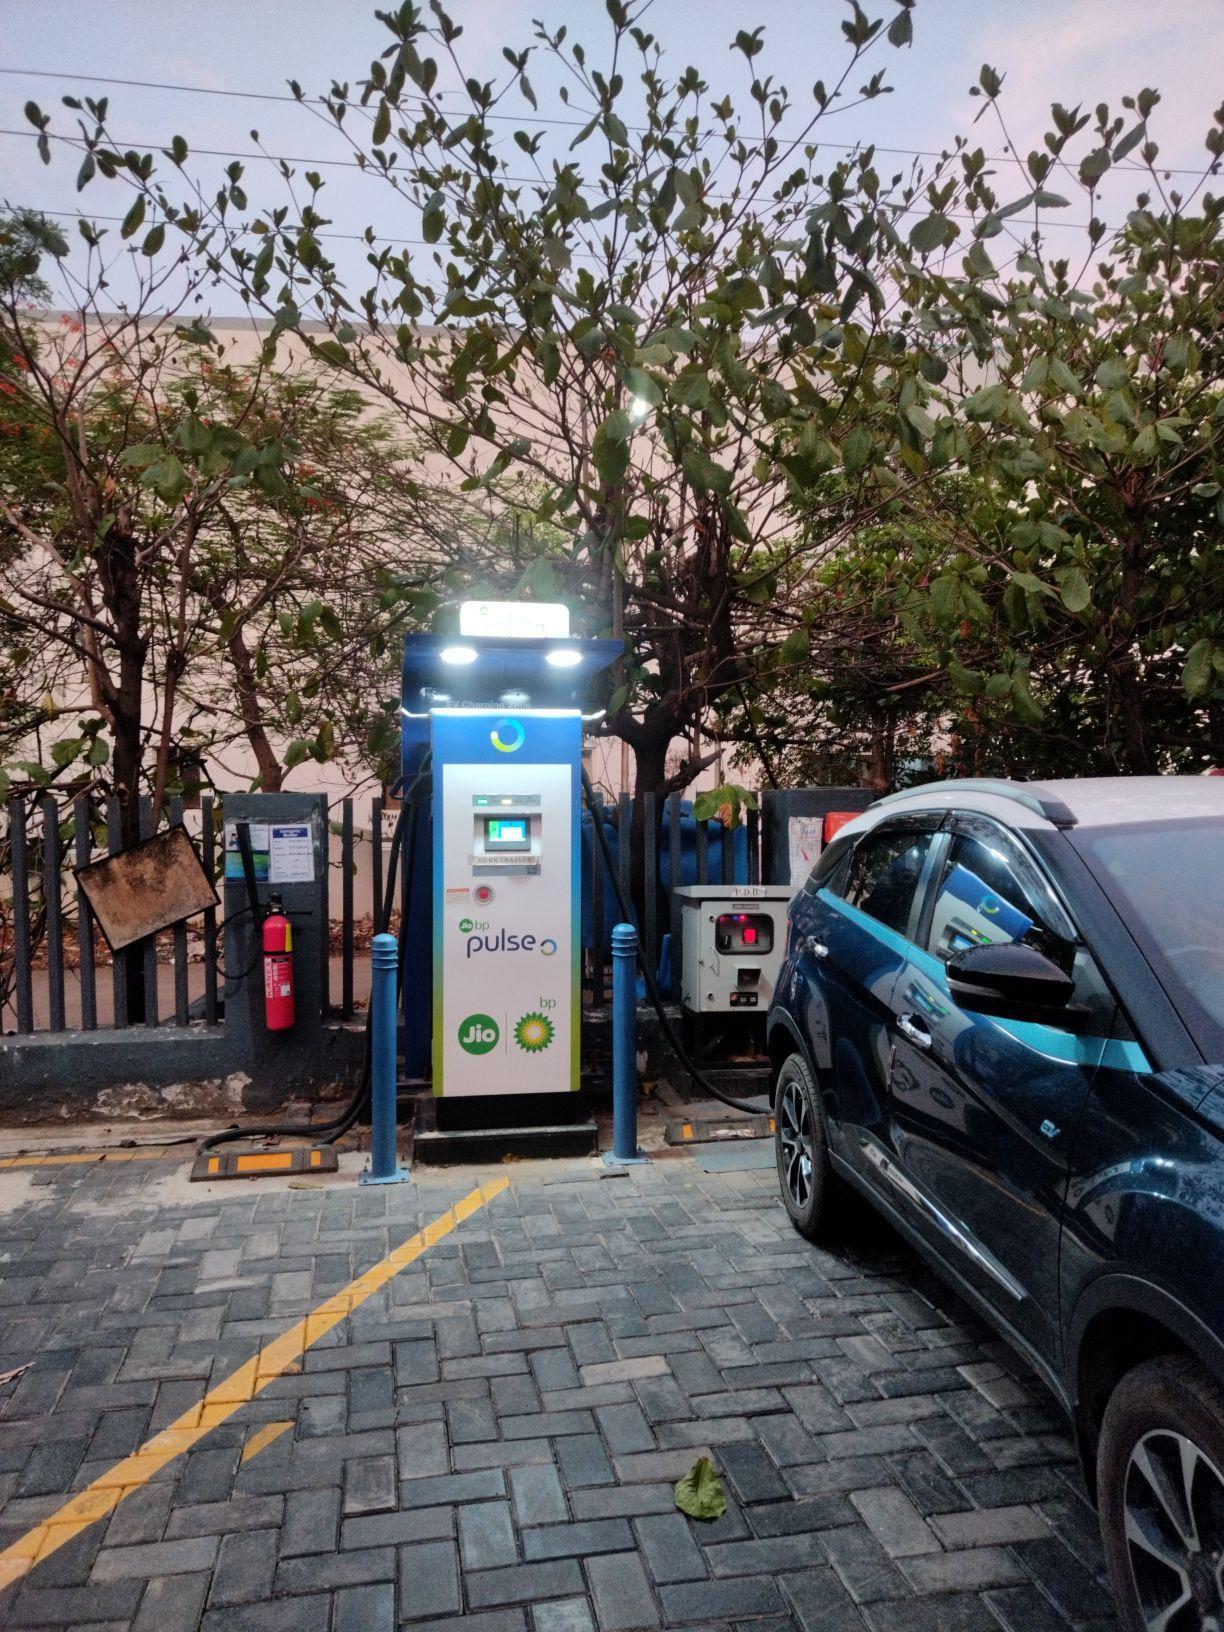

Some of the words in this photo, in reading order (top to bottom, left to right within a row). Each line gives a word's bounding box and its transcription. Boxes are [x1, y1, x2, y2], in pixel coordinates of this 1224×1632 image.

[475, 919, 490, 933] bp
[467, 928, 536, 958] pulse
[539, 996, 557, 1011] bp
[463, 1023, 496, 1043] Jio
